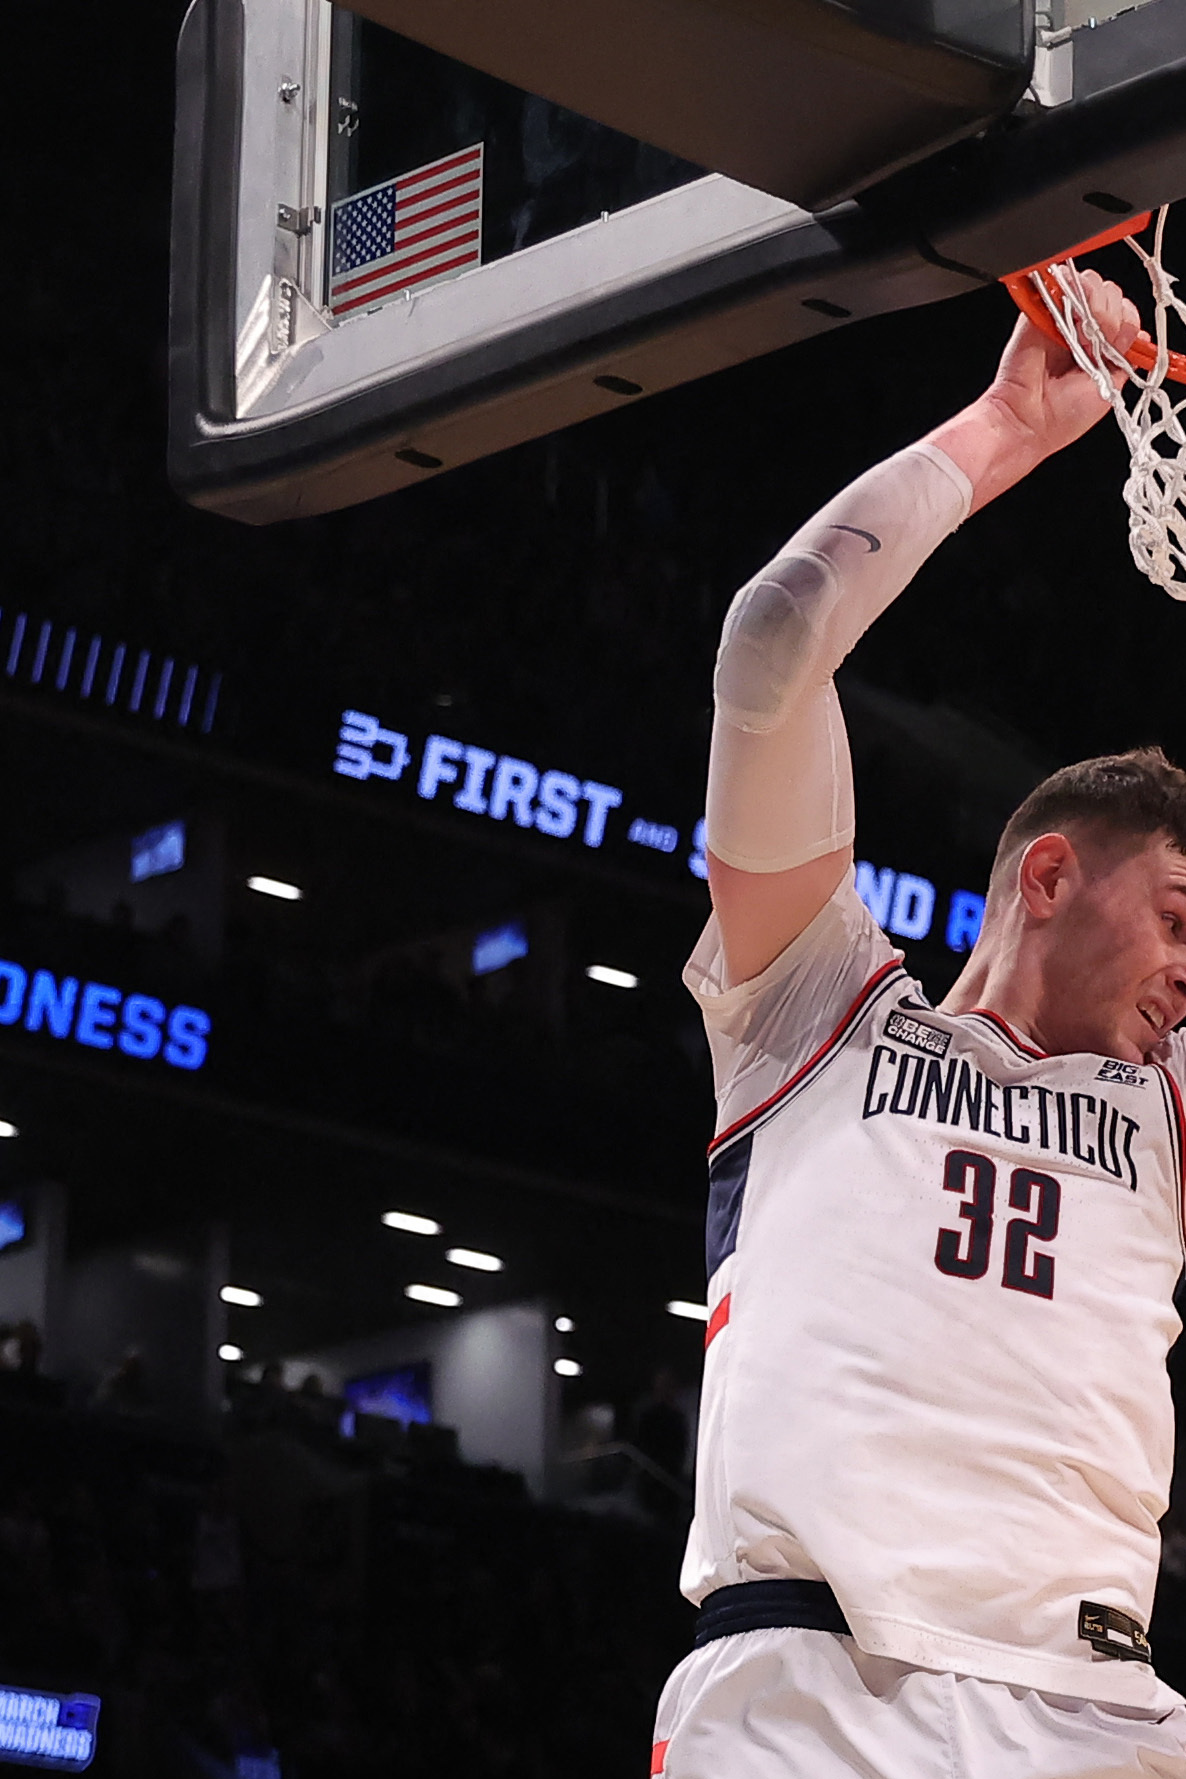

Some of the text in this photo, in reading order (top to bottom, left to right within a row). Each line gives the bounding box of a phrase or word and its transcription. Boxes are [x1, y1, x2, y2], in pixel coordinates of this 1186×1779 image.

[419, 735, 623, 848] FIRST
[887, 1025, 946, 1055] CHANGE
[902, 1019, 932, 1038] BE
[1097, 1069, 1149, 1085] EAST
[1102, 1060, 1139, 1074] BIG
[862, 1044, 1141, 1193] CONNECTICUT
[935, 1149, 1061, 1301] 32
